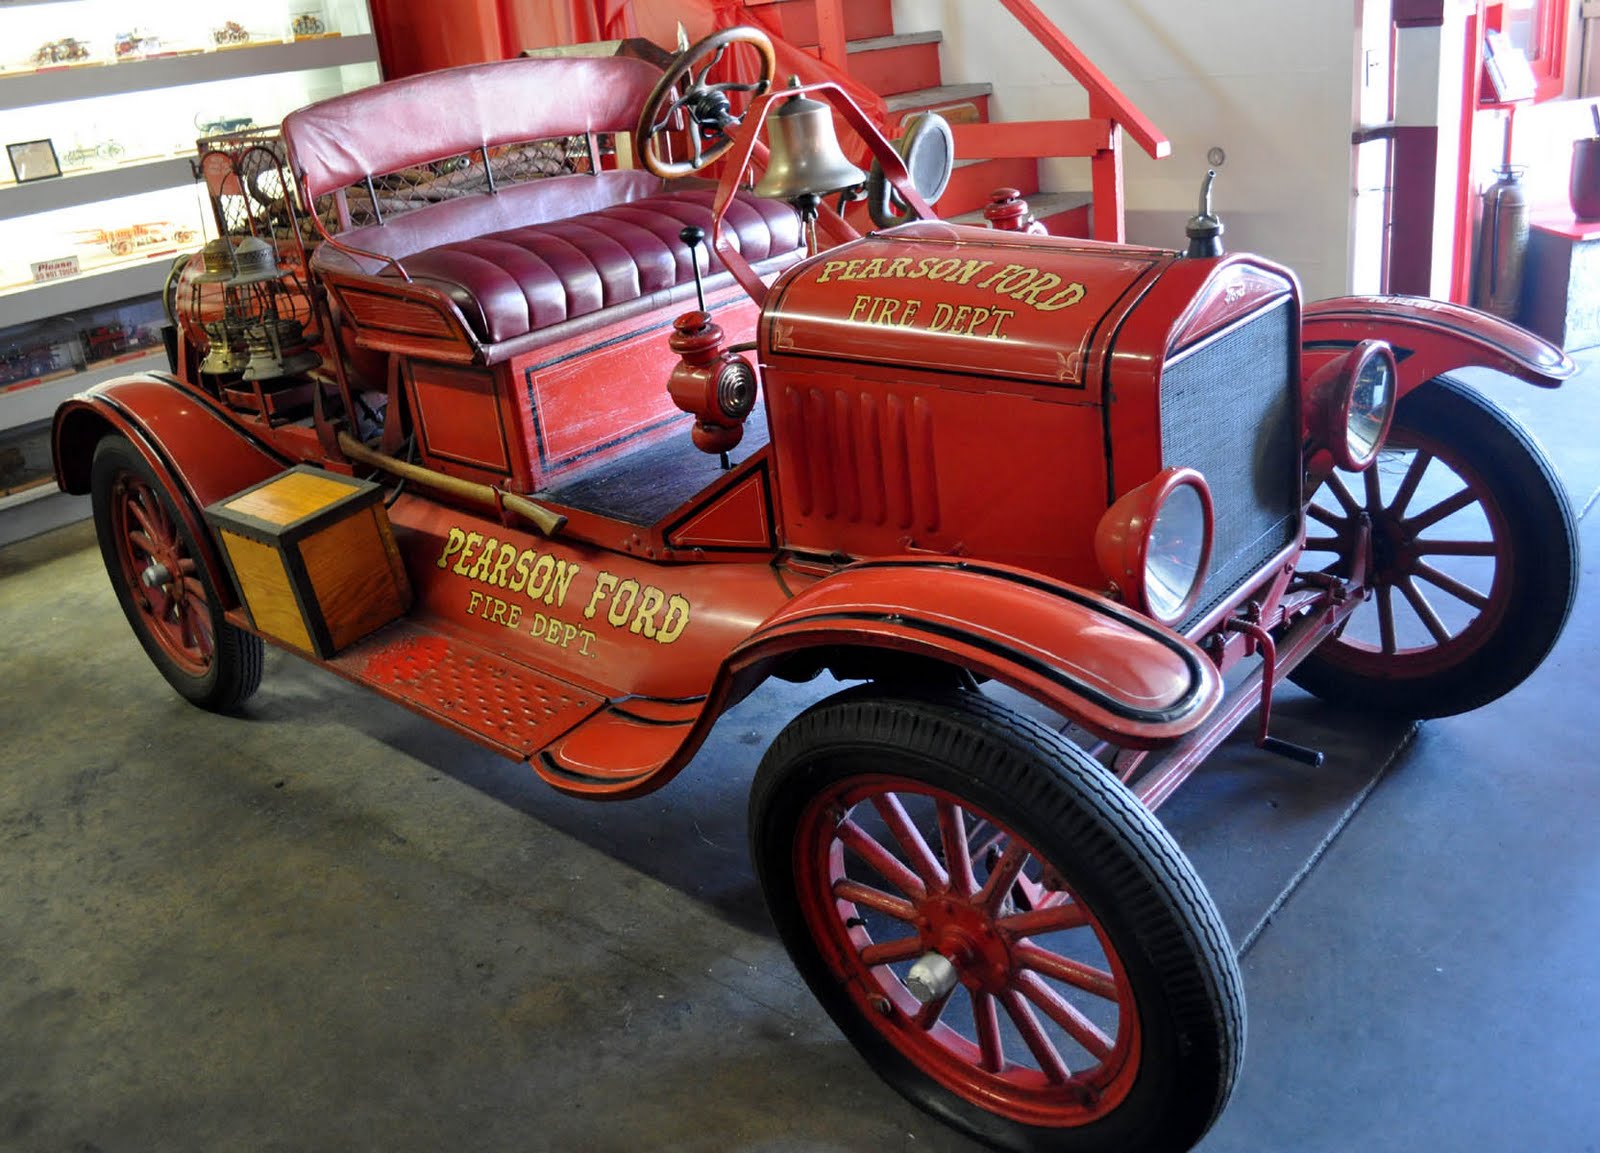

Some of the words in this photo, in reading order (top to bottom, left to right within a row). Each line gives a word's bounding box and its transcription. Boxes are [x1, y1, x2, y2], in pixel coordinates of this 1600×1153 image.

[38, 261, 73, 272] Please
[815, 256, 995, 284] PEARSON
[975, 262, 1088, 312] FORD
[846, 294, 921, 329] FIRE
[436, 526, 580, 607] PEARSON
[583, 571, 692, 645] FORD
[466, 591, 523, 630] FIRE
